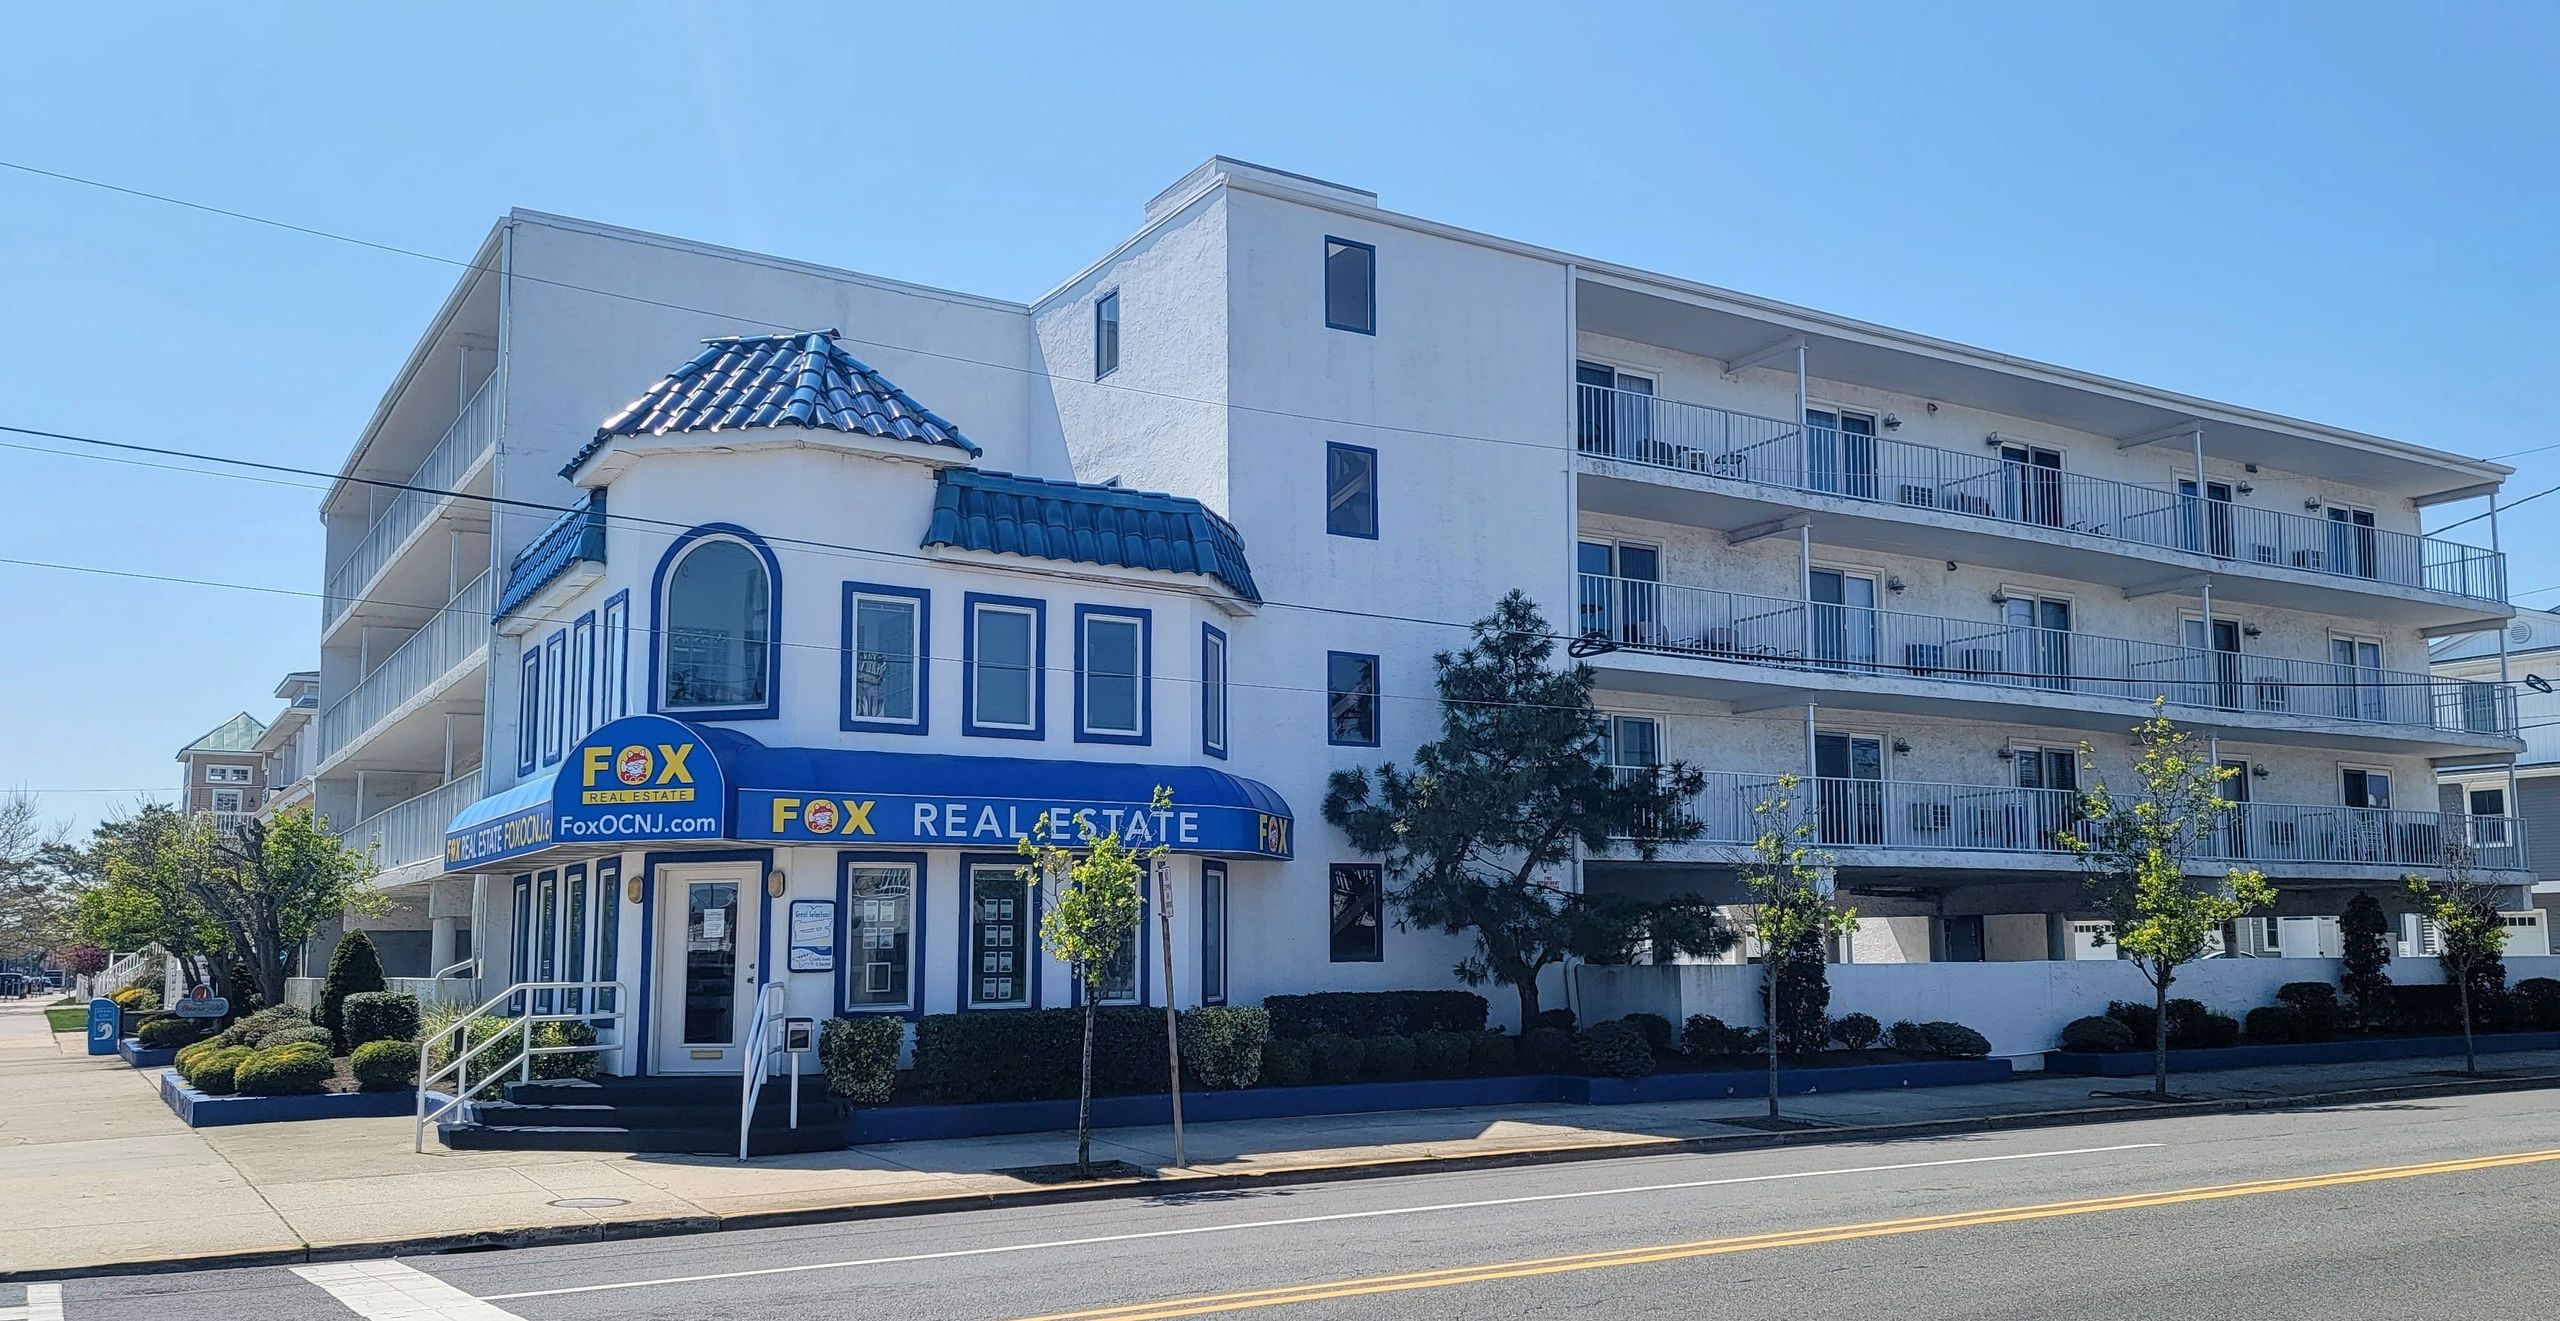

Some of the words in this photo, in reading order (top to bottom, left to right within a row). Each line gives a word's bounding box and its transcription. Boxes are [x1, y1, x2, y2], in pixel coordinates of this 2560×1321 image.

[582, 743, 694, 787] FOX
[589, 792, 626, 802] REAL
[633, 790, 687, 801] ESTATE
[447, 837, 461, 863] FOX
[461, 833, 476, 860] REAL
[478, 824, 502, 857] ESTATE
[504, 812, 550, 850] FOXOCNJ.c
[560, 814, 716, 836] FoxOCNJ.com
[772, 798, 876, 835] FOX
[914, 803, 1029, 839] REAL
[1050, 807, 1198, 843] ESTATE
[1259, 814, 1289, 854] FOX
